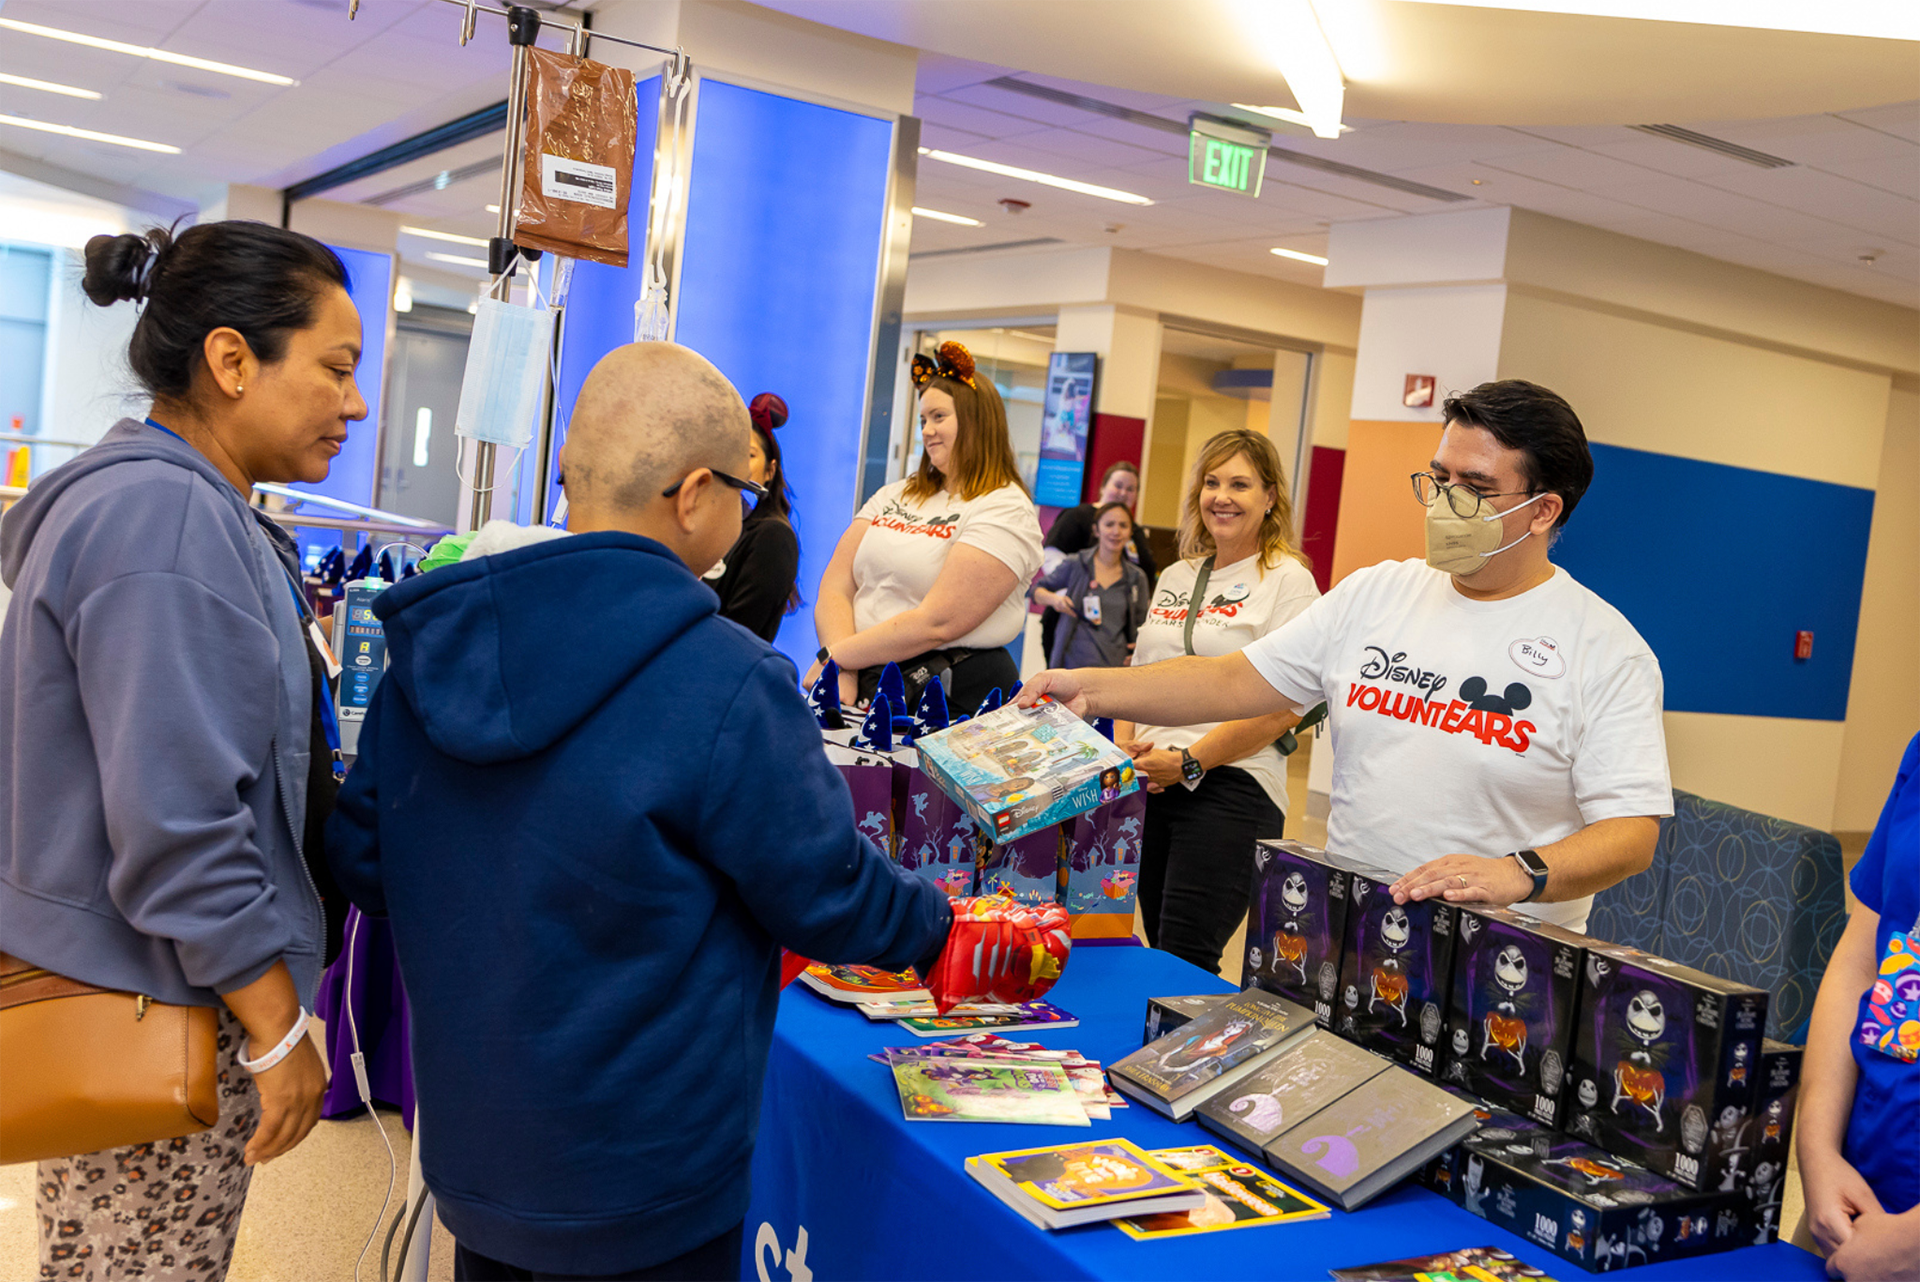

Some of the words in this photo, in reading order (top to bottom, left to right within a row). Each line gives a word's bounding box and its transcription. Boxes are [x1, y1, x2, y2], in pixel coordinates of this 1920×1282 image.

[1203, 139, 1254, 191] EXIT
[871, 514, 957, 539] VOLUNTEARS
[1521, 643, 1549, 667] Billy
[1346, 682, 1537, 754] VOLUNTEARS
[1071, 788, 1099, 809] WISH
[1010, 804, 1040, 819] Disney
[1315, 1000, 1331, 1018] 1000
[1415, 1043, 1434, 1063] 1000
[1535, 1093, 1556, 1115] 1000
[1675, 1151, 1700, 1176] 1000
[1535, 1212, 1558, 1238] 1000
